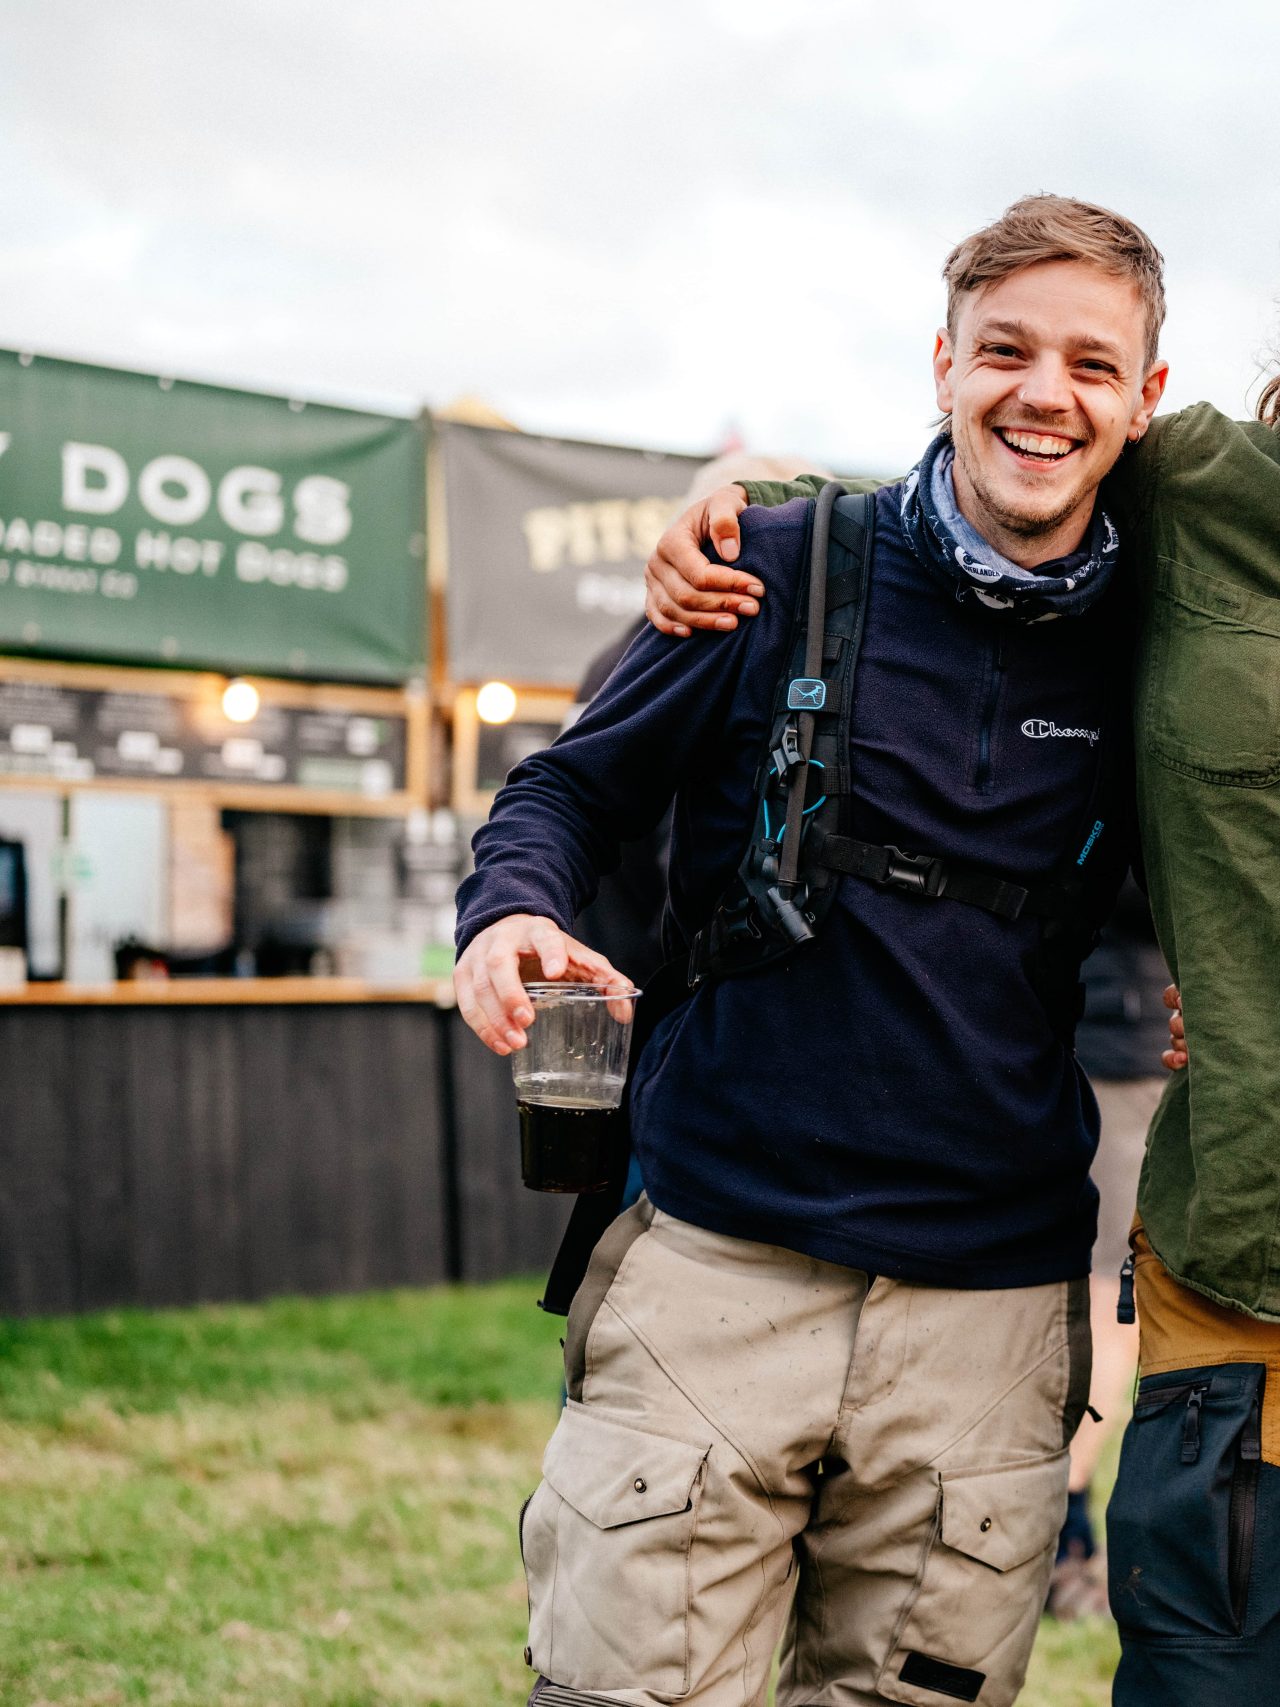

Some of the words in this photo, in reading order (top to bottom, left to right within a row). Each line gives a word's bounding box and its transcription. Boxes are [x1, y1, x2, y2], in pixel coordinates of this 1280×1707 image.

[62, 441, 352, 545] DOGS
[0, 517, 122, 565] ADED
[135, 528, 224, 577] HOT
[1021, 719, 1100, 747] Champ
[1076, 820, 1102, 865] MOSKO
